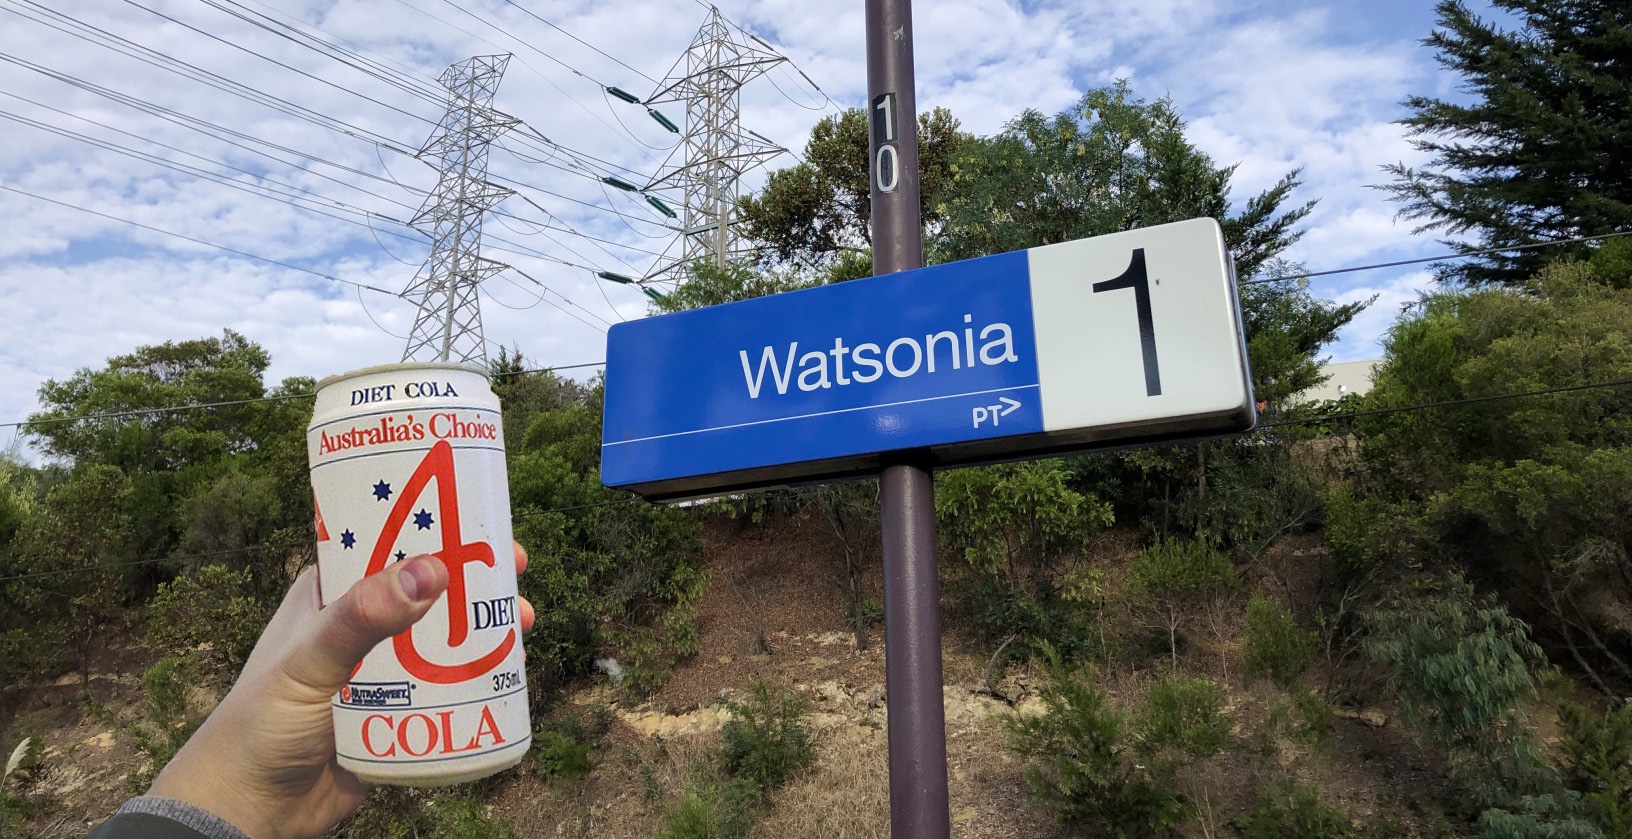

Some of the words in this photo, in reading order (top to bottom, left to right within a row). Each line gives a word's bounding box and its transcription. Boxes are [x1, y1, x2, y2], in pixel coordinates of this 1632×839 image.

[1092, 248, 1162, 397] 1
[739, 314, 1019, 399] Watsonia
[351, 384, 396, 406] DIET
[404, 382, 458, 398] COLA
[319, 414, 425, 455] Australia's
[429, 412, 497, 441] Choice
[472, 596, 516, 630] DIET
[361, 704, 506, 758] COLA
